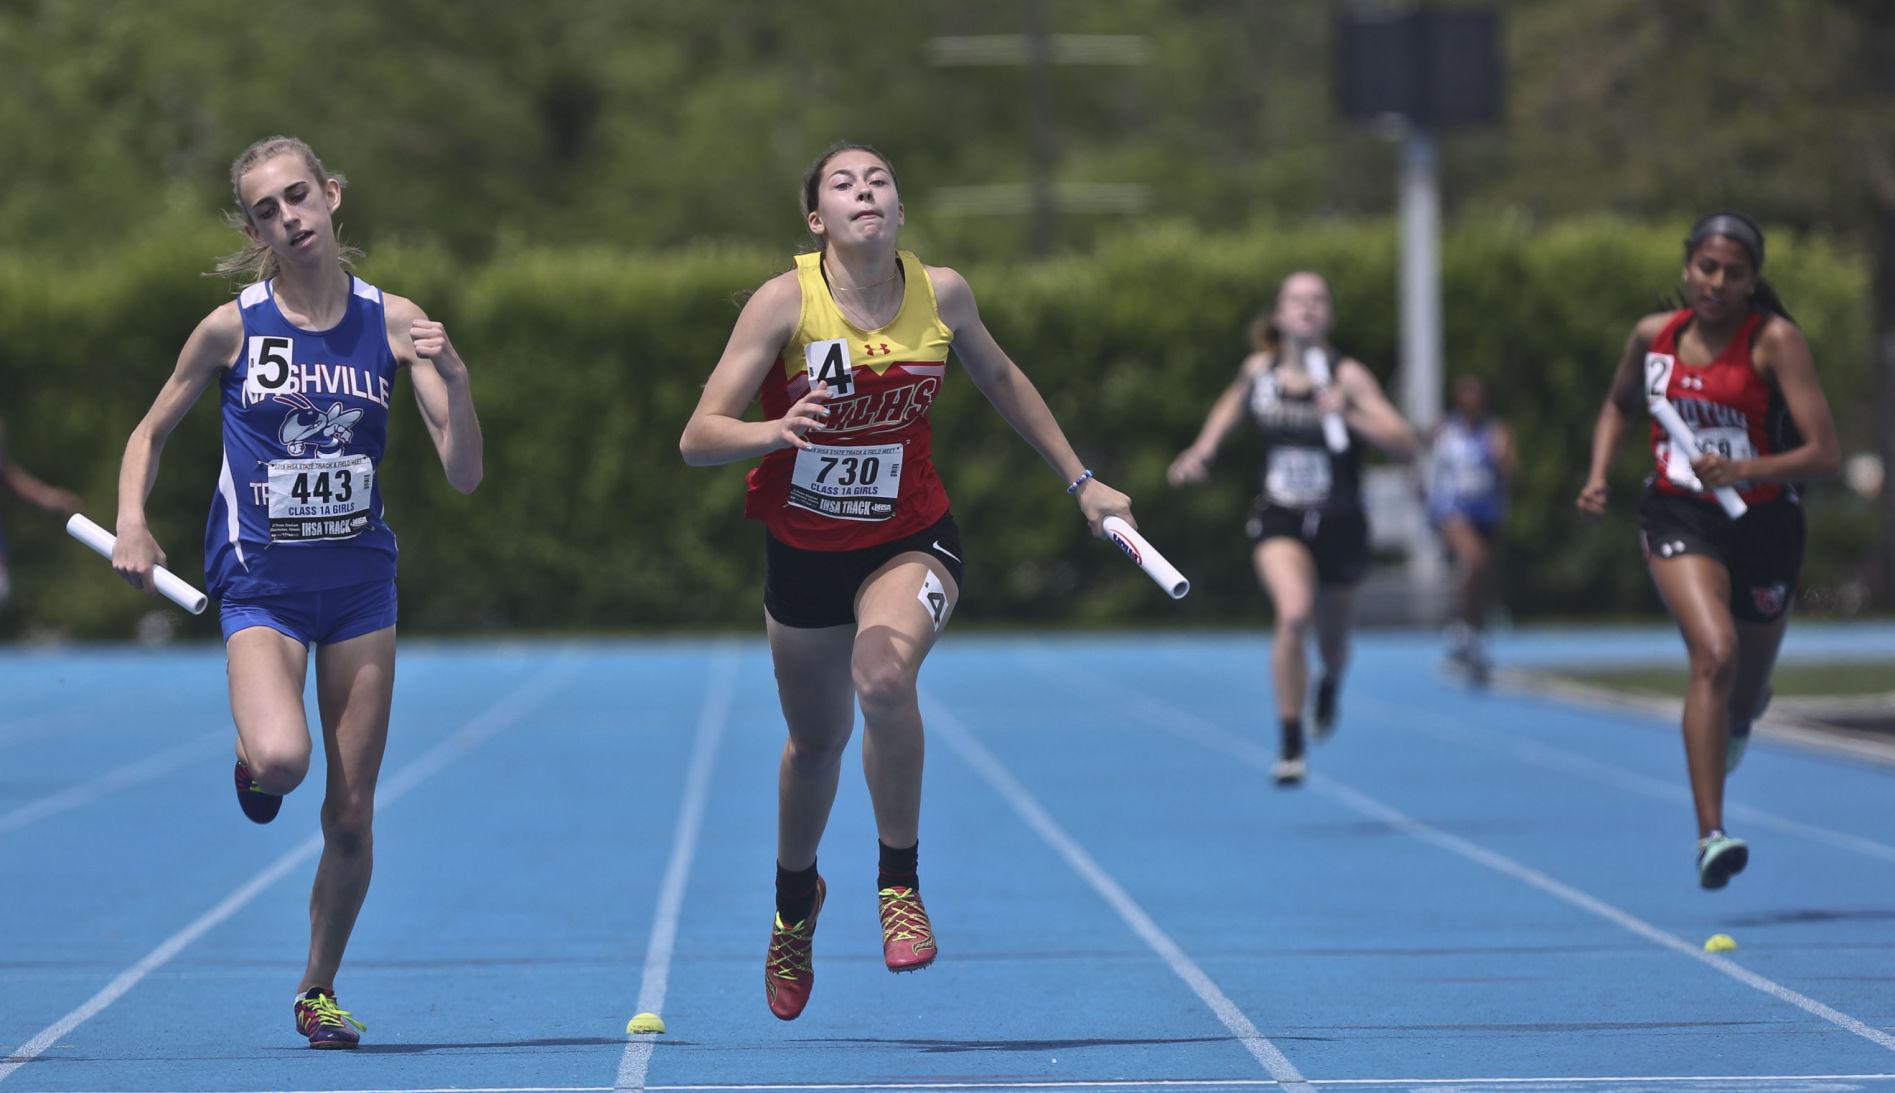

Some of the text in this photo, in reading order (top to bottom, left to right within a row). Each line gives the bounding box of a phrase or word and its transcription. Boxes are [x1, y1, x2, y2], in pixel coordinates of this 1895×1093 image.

[256, 337, 289, 389] 5
[816, 342, 853, 394] 4
[1648, 358, 1667, 396] 2
[241, 363, 390, 410] NSHVILLE
[291, 469, 353, 505] 443
[816, 456, 880, 486] 730
[810, 483, 879, 496] CLASS 1A GIRLS
[288, 502, 355, 516] CLASS 1A GIRLS
[819, 498, 841, 514] IHSA
[842, 501, 871, 516] TRACK
[301, 521, 323, 537] IHSA
[323, 519, 351, 535] TRACK
[926, 591, 946, 623] 4
